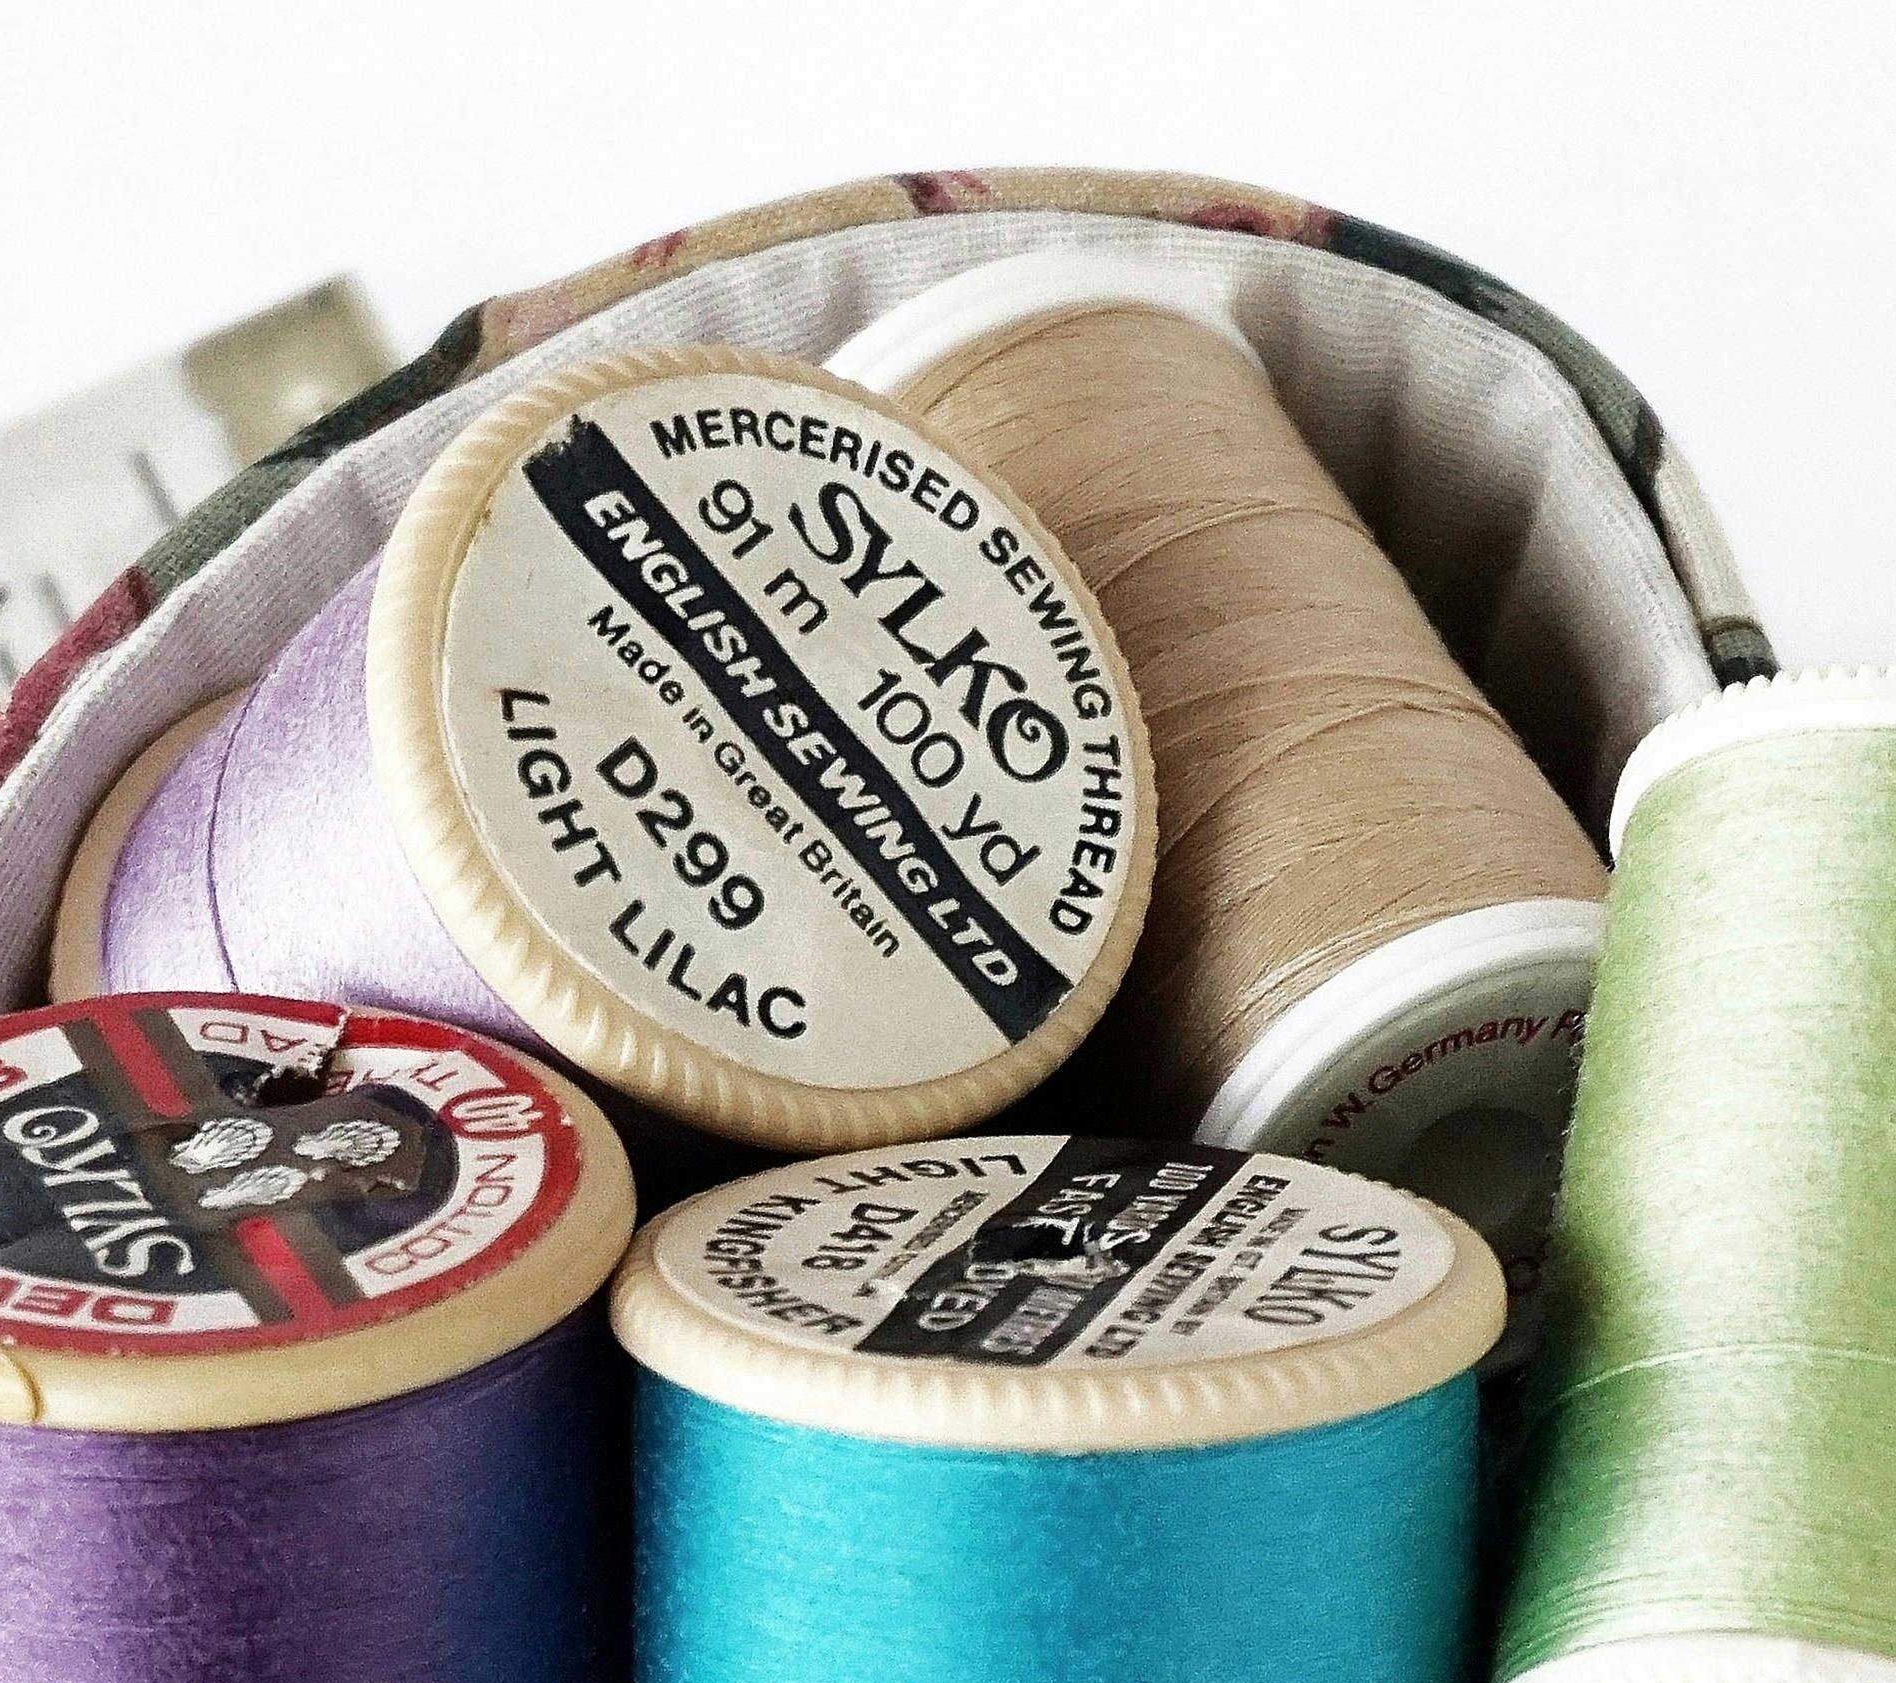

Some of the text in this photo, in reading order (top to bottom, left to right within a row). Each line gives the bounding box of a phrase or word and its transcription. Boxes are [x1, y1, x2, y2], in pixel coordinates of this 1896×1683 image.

[650, 407, 1121, 936] MERCERISED SEWING THREAD
[698, 477, 1041, 886] 91 m 100 yd
[789, 481, 1070, 784] SYLKO
[584, 488, 1019, 987] ENGLISH SEWING LTD
[587, 606, 901, 958] Made in Great Britain
[498, 687, 809, 1040] LIGHT LILAC
[595, 735, 766, 932] D299
[1368, 1015, 1549, 1094] Germany
[2, 1105, 195, 1278] SYLKO
[364, 1151, 520, 1275] COTTON
[703, 1153, 1028, 1335] LIGHT KINGFISHER
[801, 1201, 920, 1271] D418
[1010, 1173, 1122, 1246] FAST
[1149, 1161, 1215, 1191] 100
[1186, 1174, 1292, 1249] ENGLISH
[916, 1259, 1019, 1333] DYED
[1119, 1250, 1217, 1324] SEWING
[1243, 1222, 1401, 1326] SYLKO
